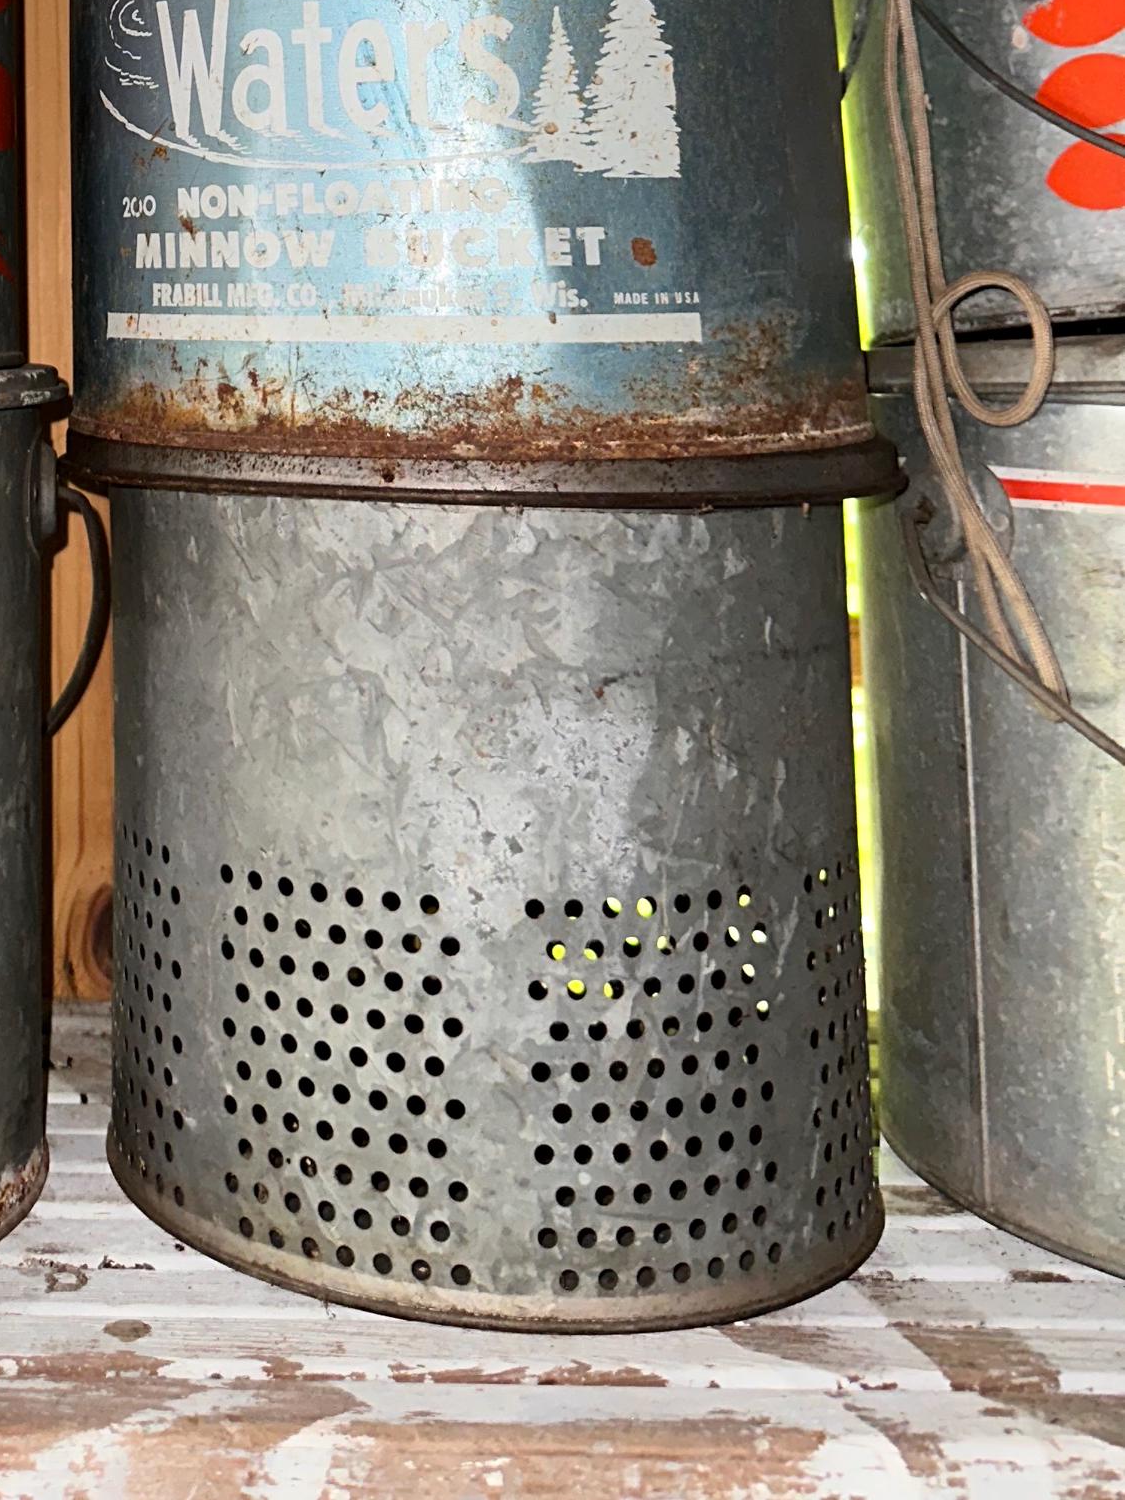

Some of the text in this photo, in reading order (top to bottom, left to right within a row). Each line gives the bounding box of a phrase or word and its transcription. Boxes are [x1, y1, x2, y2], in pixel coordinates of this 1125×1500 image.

[122, 194, 157, 218] 200
[177, 177, 510, 220] NON-FLOATING
[135, 225, 607, 269] MINNOW BUCKET
[152, 282, 223, 308] FRABILL
[530, 279, 589, 308] Wis.
[613, 292, 649, 305] MADE
[655, 292, 669, 305] IN
